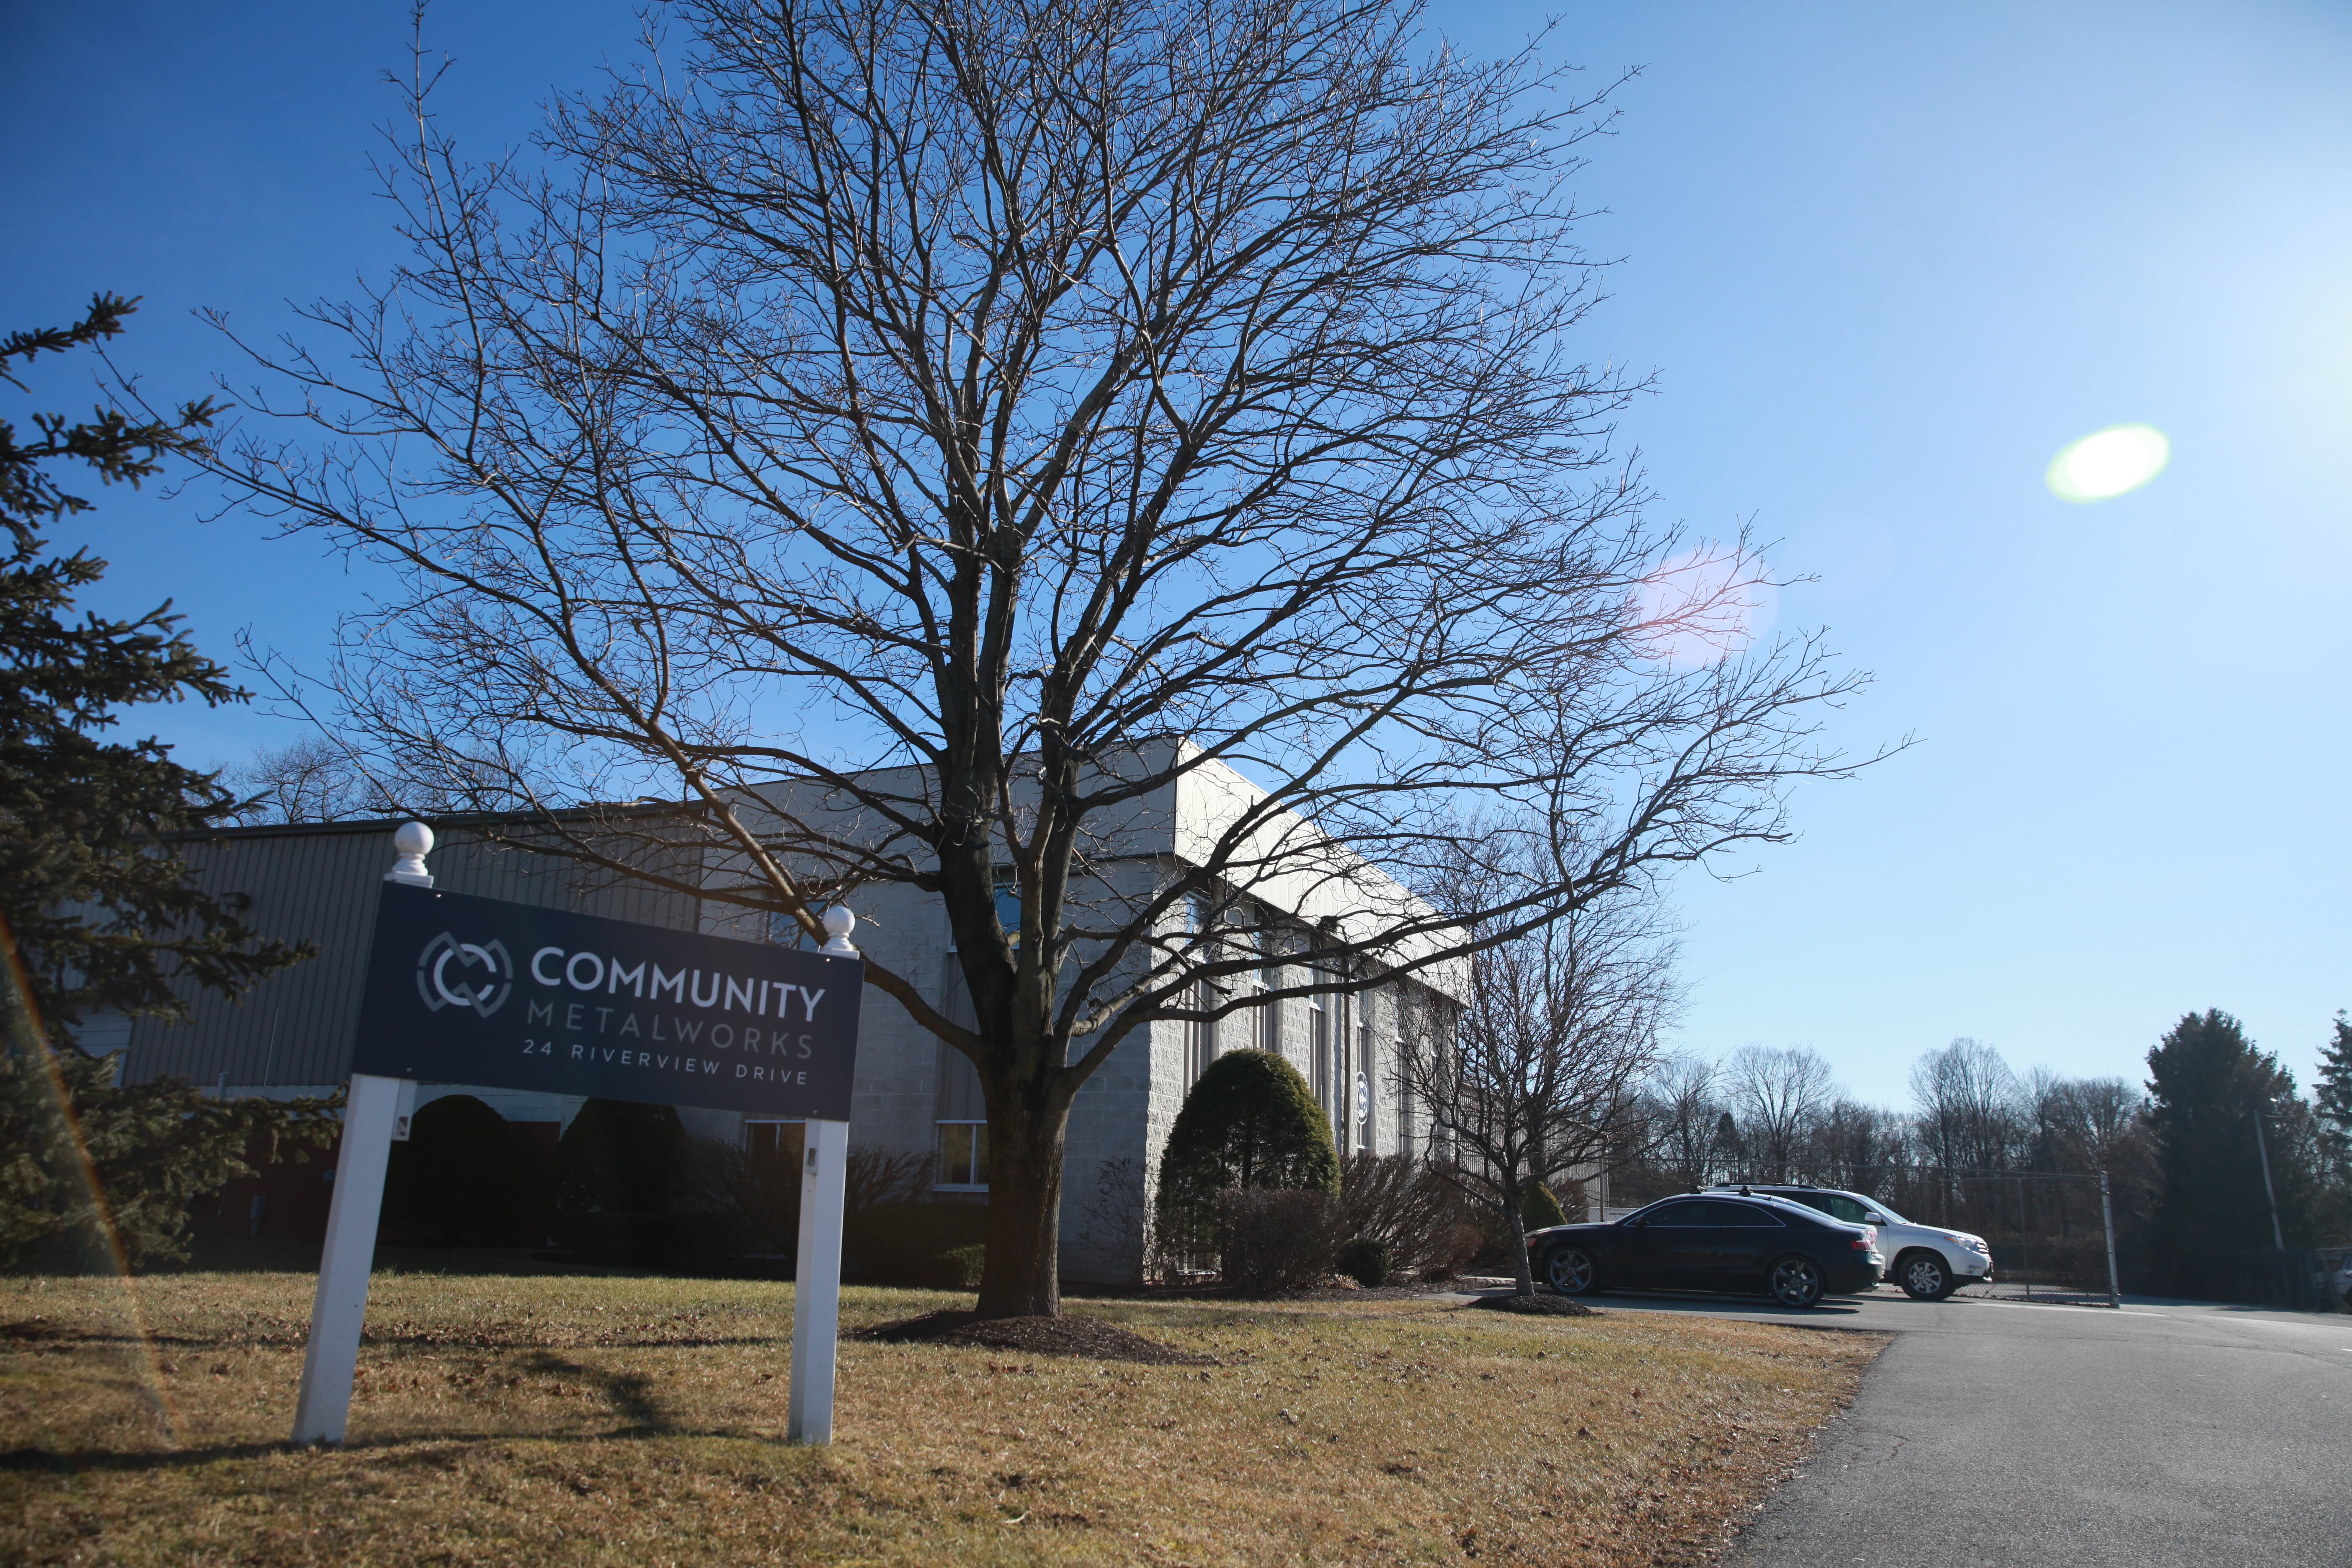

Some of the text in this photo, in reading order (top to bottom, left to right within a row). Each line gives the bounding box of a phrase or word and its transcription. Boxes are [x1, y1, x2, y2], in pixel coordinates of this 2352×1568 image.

[531, 946, 826, 1022] COMMUNITY
[527, 999, 812, 1059] METALWORKS
[522, 1039, 807, 1085] 24 RIVERVIEW DRIVE
